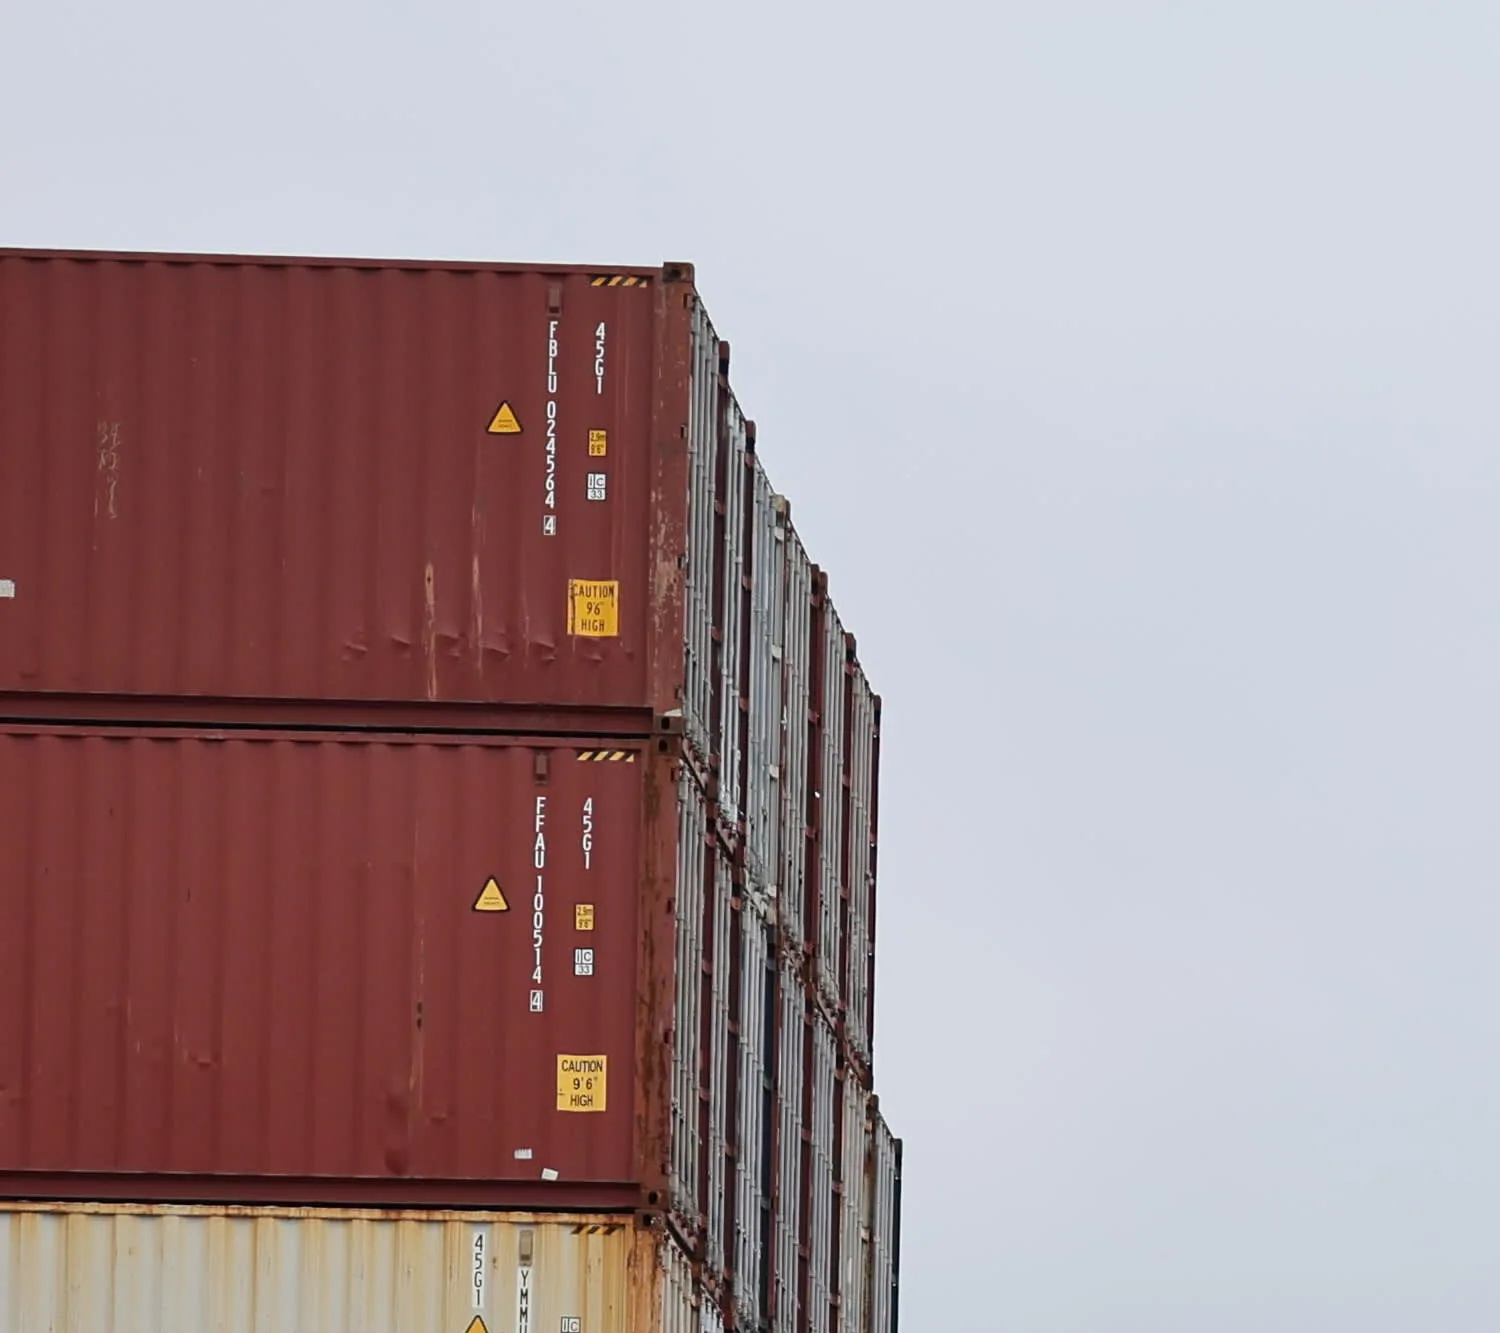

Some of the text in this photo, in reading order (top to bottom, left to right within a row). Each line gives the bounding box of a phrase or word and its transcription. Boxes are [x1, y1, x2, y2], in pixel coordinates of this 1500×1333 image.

[547, 321, 559, 394] FBLU
[594, 322, 606, 394] 45G1
[545, 401, 557, 508] 024564
[573, 584, 615, 598] CAUTION
[581, 619, 605, 632] HIGH
[534, 796, 547, 869] FFAU
[582, 797, 593, 870] 45G1
[532, 875, 544, 984] 100514
[561, 1059, 603, 1073] CAUTION
[570, 1094, 594, 1107] HIGH
[473, 1234, 484, 1306] 45G1
